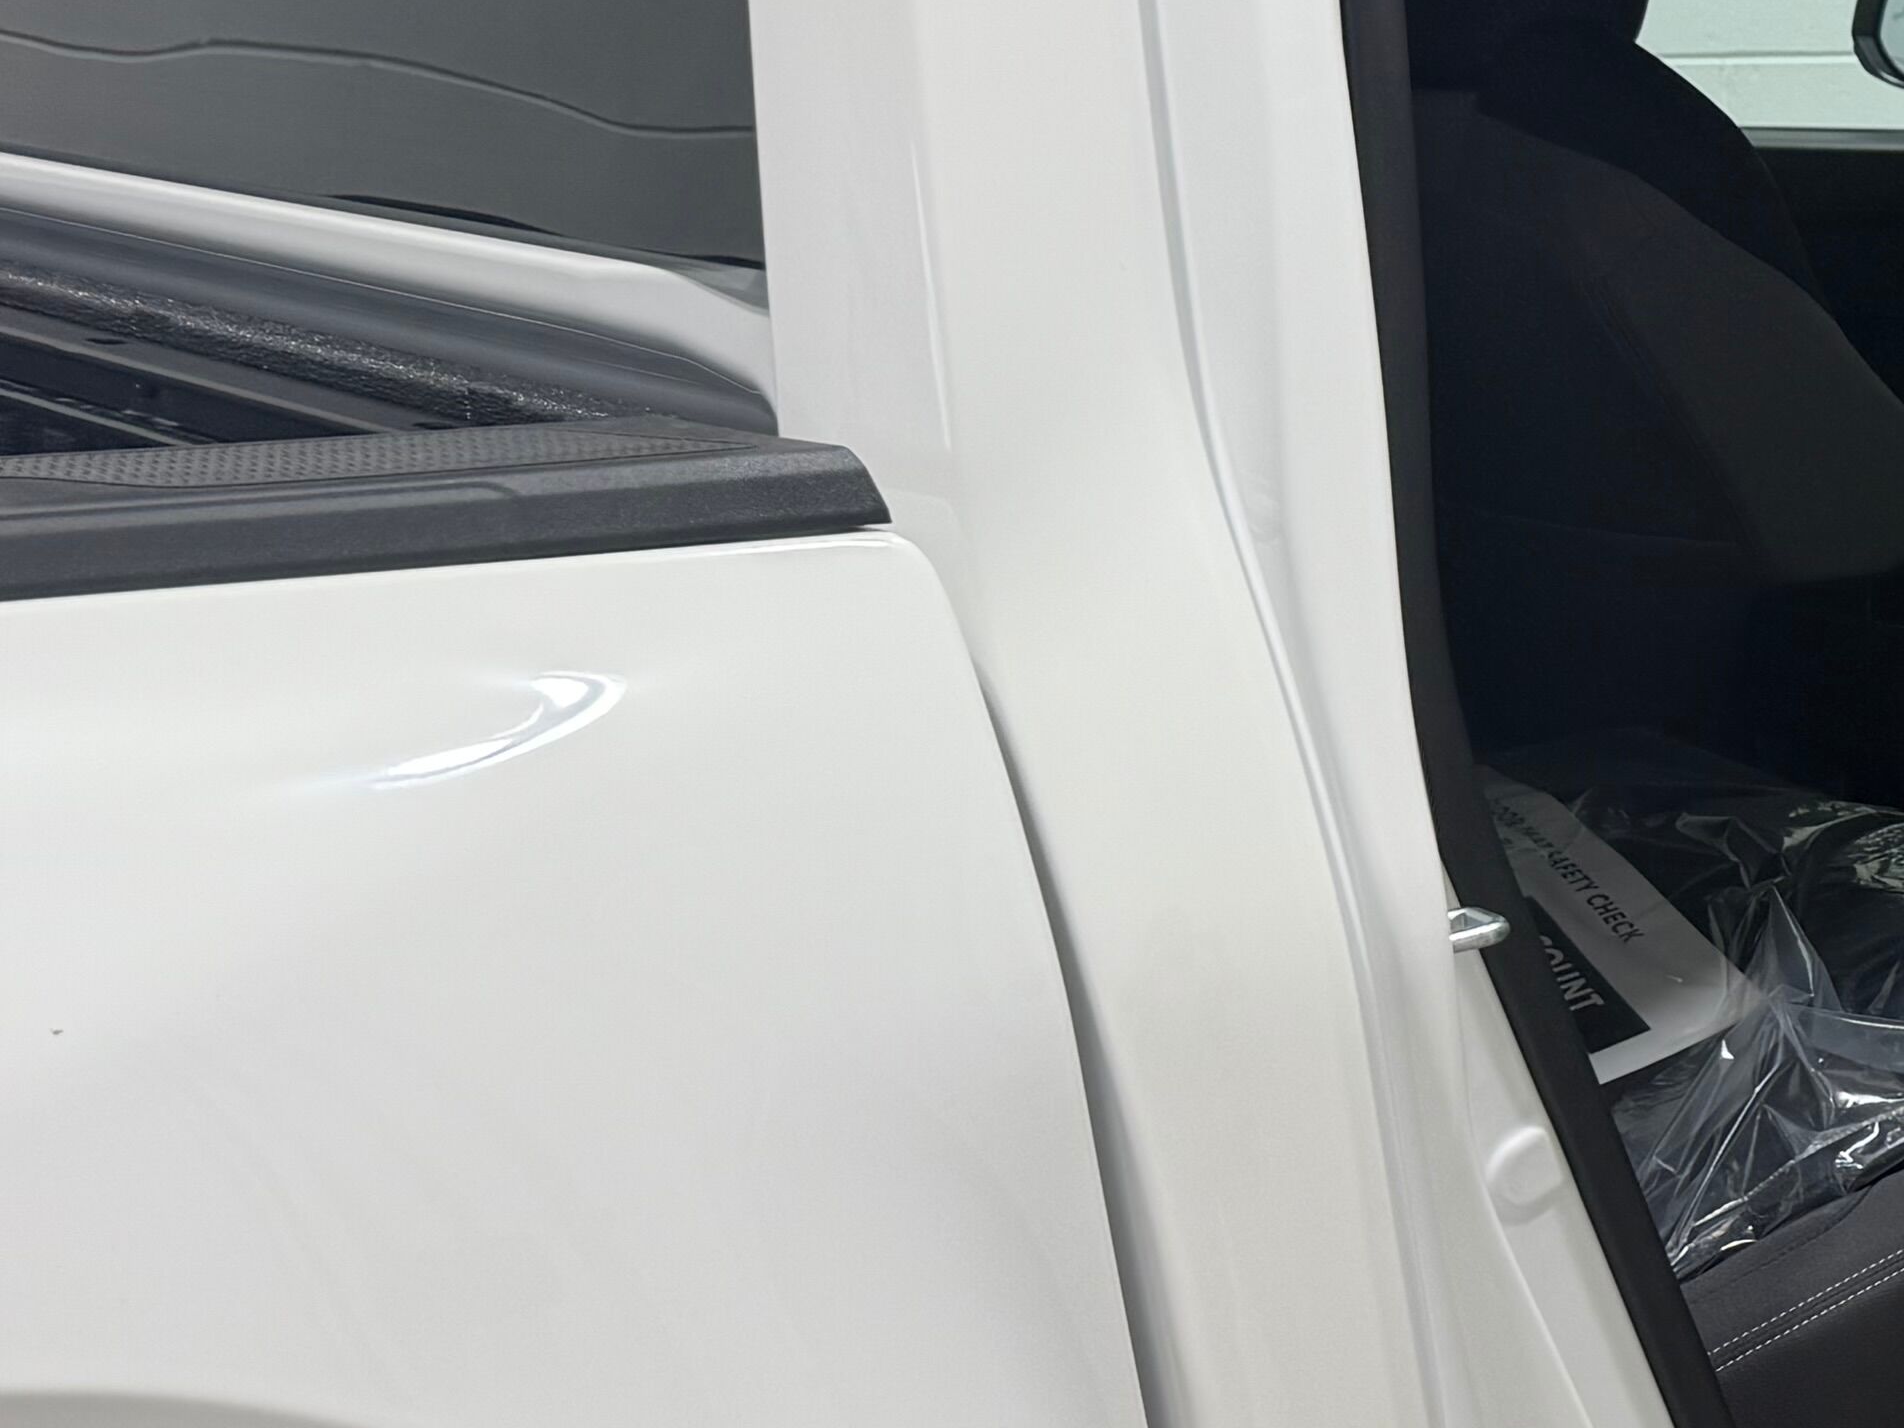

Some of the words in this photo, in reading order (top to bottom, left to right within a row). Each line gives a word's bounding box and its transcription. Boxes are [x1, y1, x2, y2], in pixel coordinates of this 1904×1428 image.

[1547, 849, 1600, 893] SAFETY
[1585, 893, 1646, 943] CHECK
[1538, 934, 1606, 1012] OUNT
